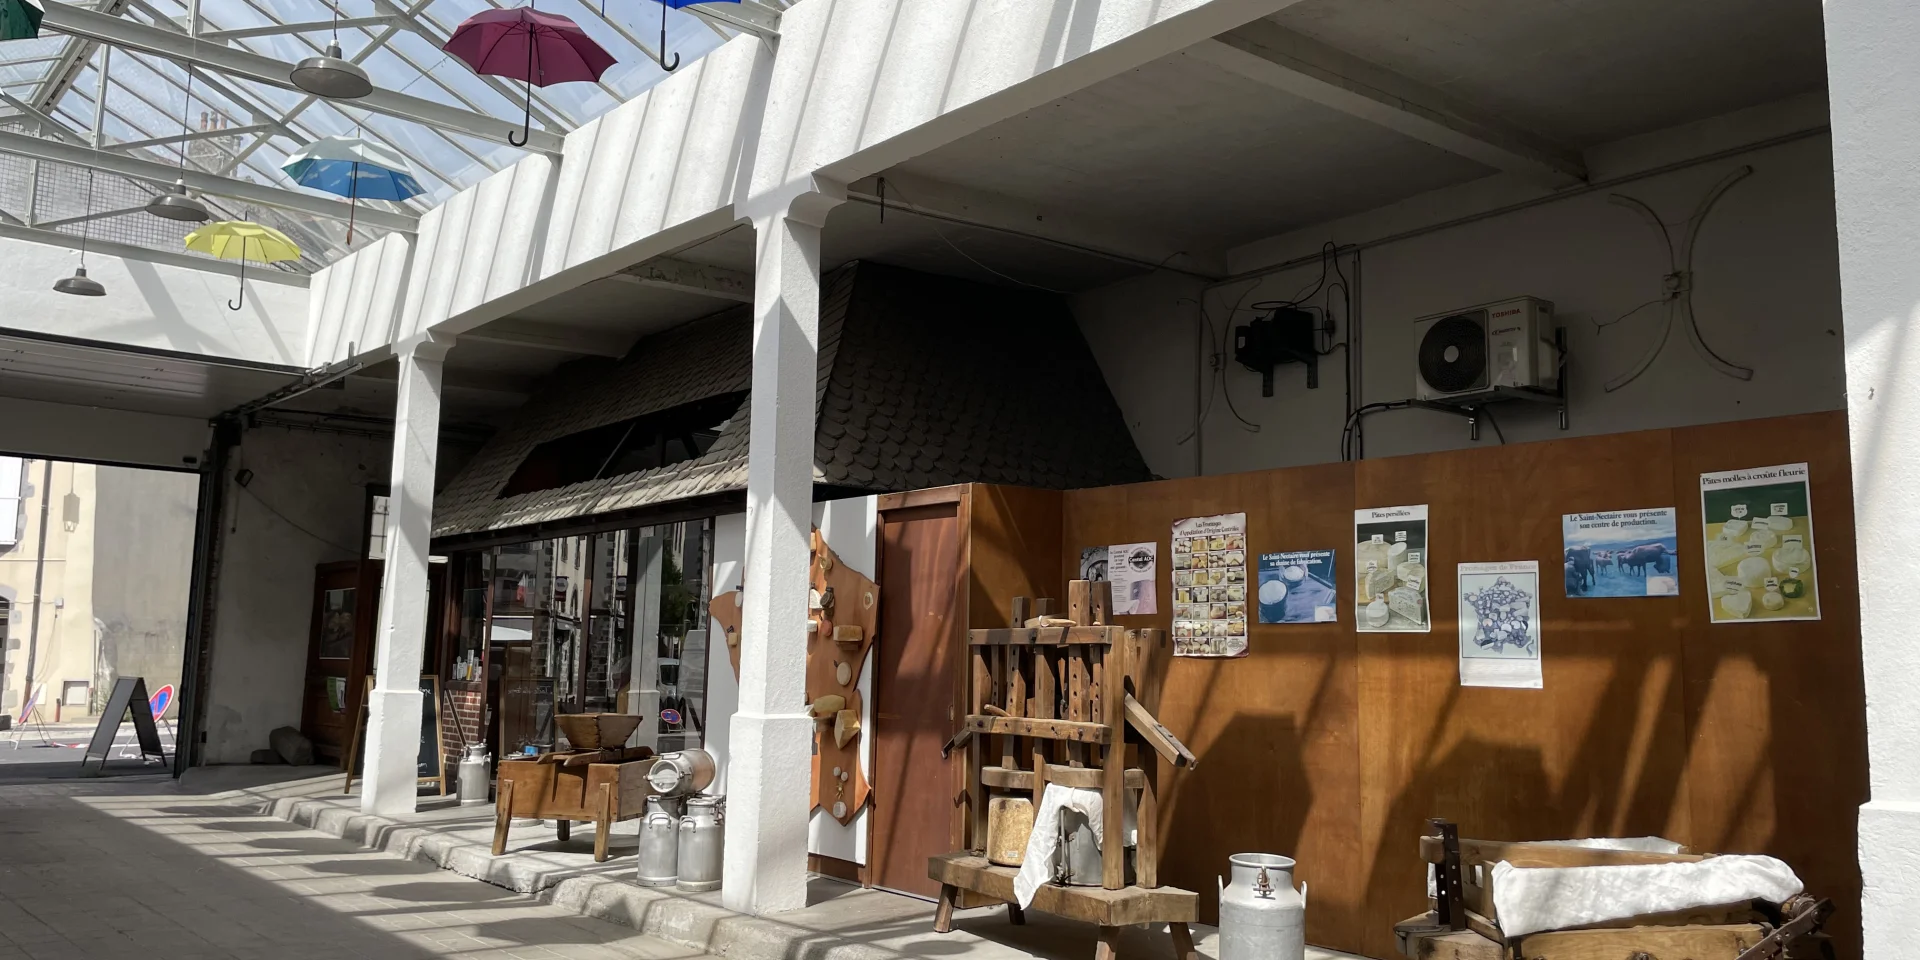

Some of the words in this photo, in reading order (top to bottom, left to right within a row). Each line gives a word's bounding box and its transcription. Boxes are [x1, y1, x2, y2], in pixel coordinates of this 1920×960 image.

[1491, 308, 1522, 319] TOSHIBA
[1722, 474, 1747, 483] molles
[1752, 470, 1778, 480] croûte
[1778, 467, 1806, 477] fleurie
[1579, 513, 1622, 521] Saint-Nectaire
[1639, 509, 1668, 519] présente
[1268, 552, 1299, 560] Saint-Nectaire
[1310, 551, 1331, 559] présente
[1460, 564, 1498, 572] Fromages
